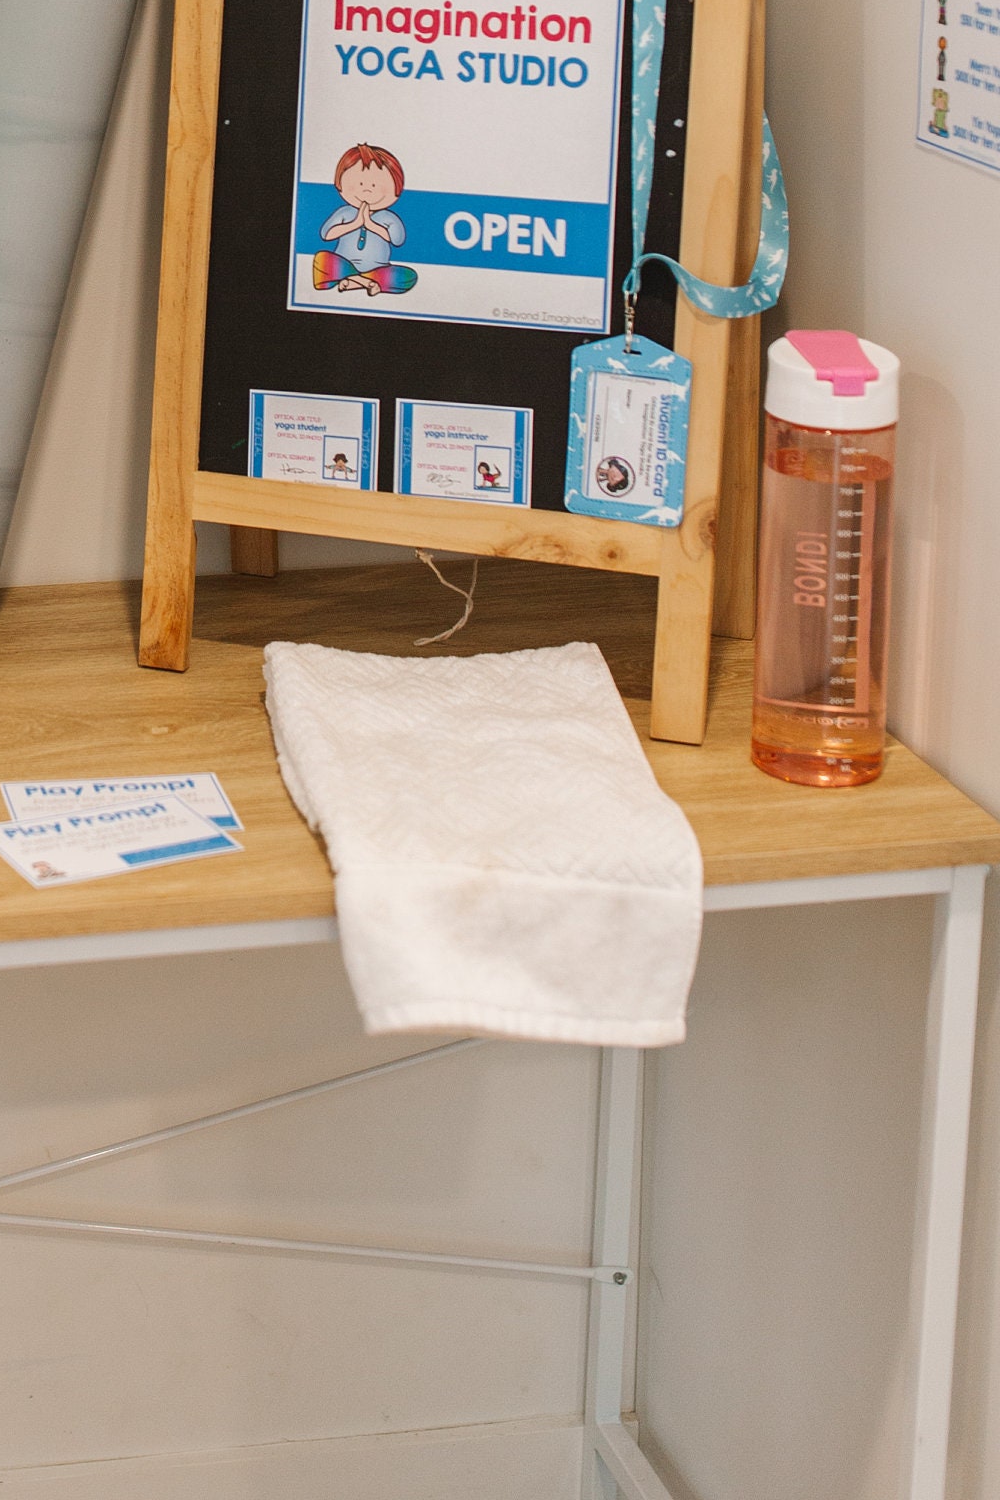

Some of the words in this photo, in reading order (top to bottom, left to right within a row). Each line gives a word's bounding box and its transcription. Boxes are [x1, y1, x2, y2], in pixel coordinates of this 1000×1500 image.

[335, 44, 444, 81] YOGA
[457, 50, 589, 88] STUDIO
[444, 211, 567, 257] OPEN
[503, 308, 539, 323] Beyond
[542, 311, 600, 326] Imagination
[275, 422, 295, 432] yoga
[297, 422, 327, 432] student
[655, 394, 671, 448] Student
[424, 431, 445, 440] yoga
[447, 430, 488, 440] instructor
[656, 448, 667, 461] ID
[653, 463, 664, 497] card
[24, 784, 83, 797] Play
[93, 777, 196, 795] Prompt
[2, 821, 62, 840] Play
[67, 801, 168, 829] Prompt
